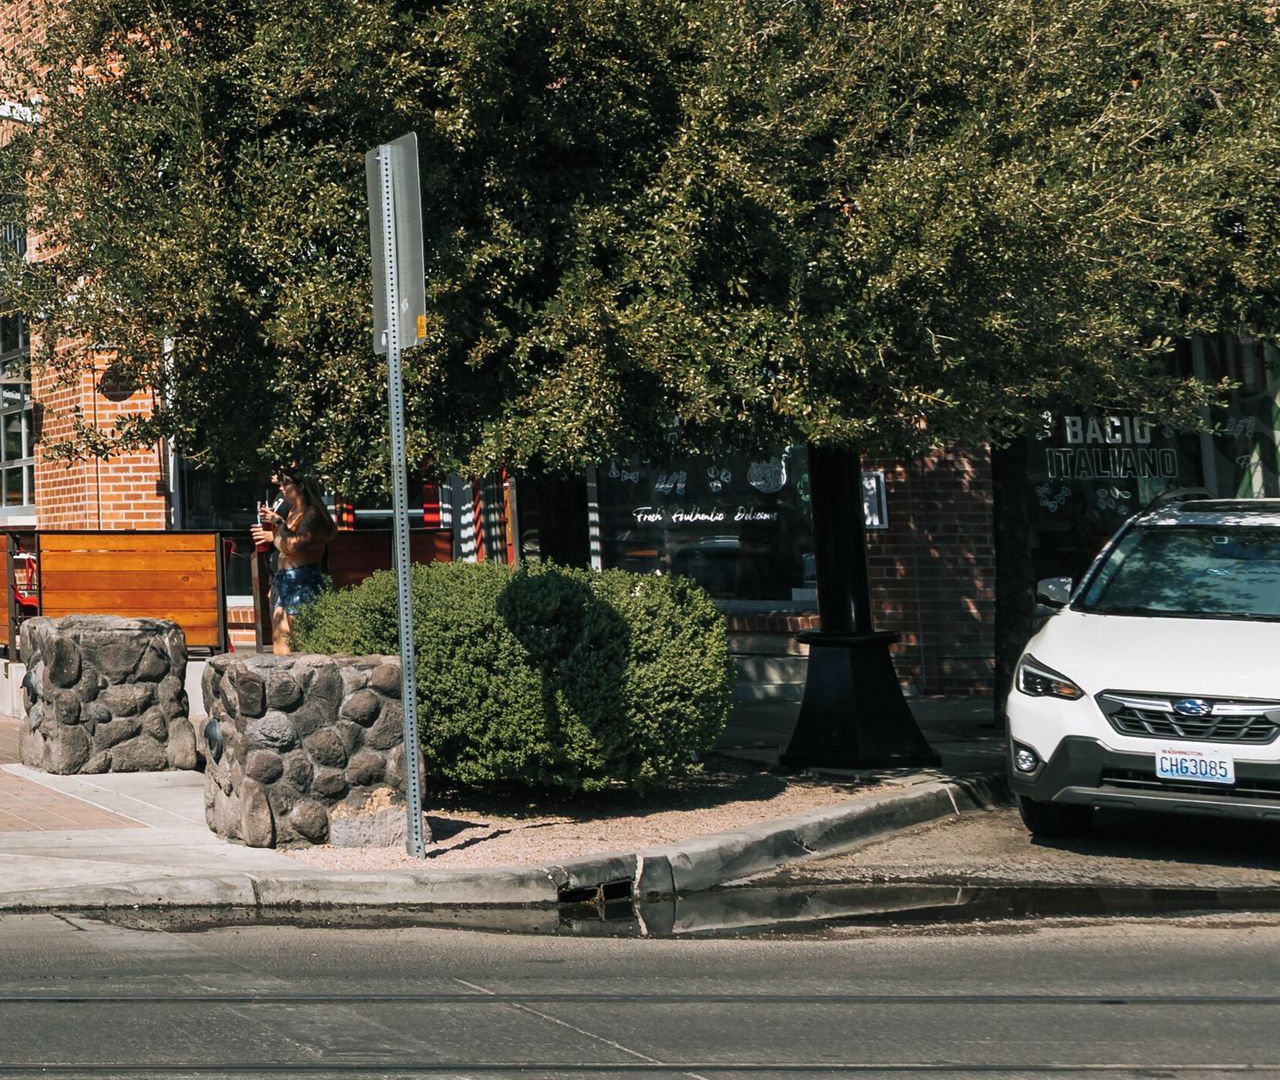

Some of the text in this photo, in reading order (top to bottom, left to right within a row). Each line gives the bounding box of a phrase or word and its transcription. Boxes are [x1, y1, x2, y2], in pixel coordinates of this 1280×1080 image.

[1065, 415, 1153, 444] BACIO
[1046, 448, 1178, 478] ITALIANO
[632, 505, 778, 523] Fresh Authentic Delicious
[1161, 749, 1203, 757] WASHINGTON
[1160, 756, 1228, 777] CHG3085
